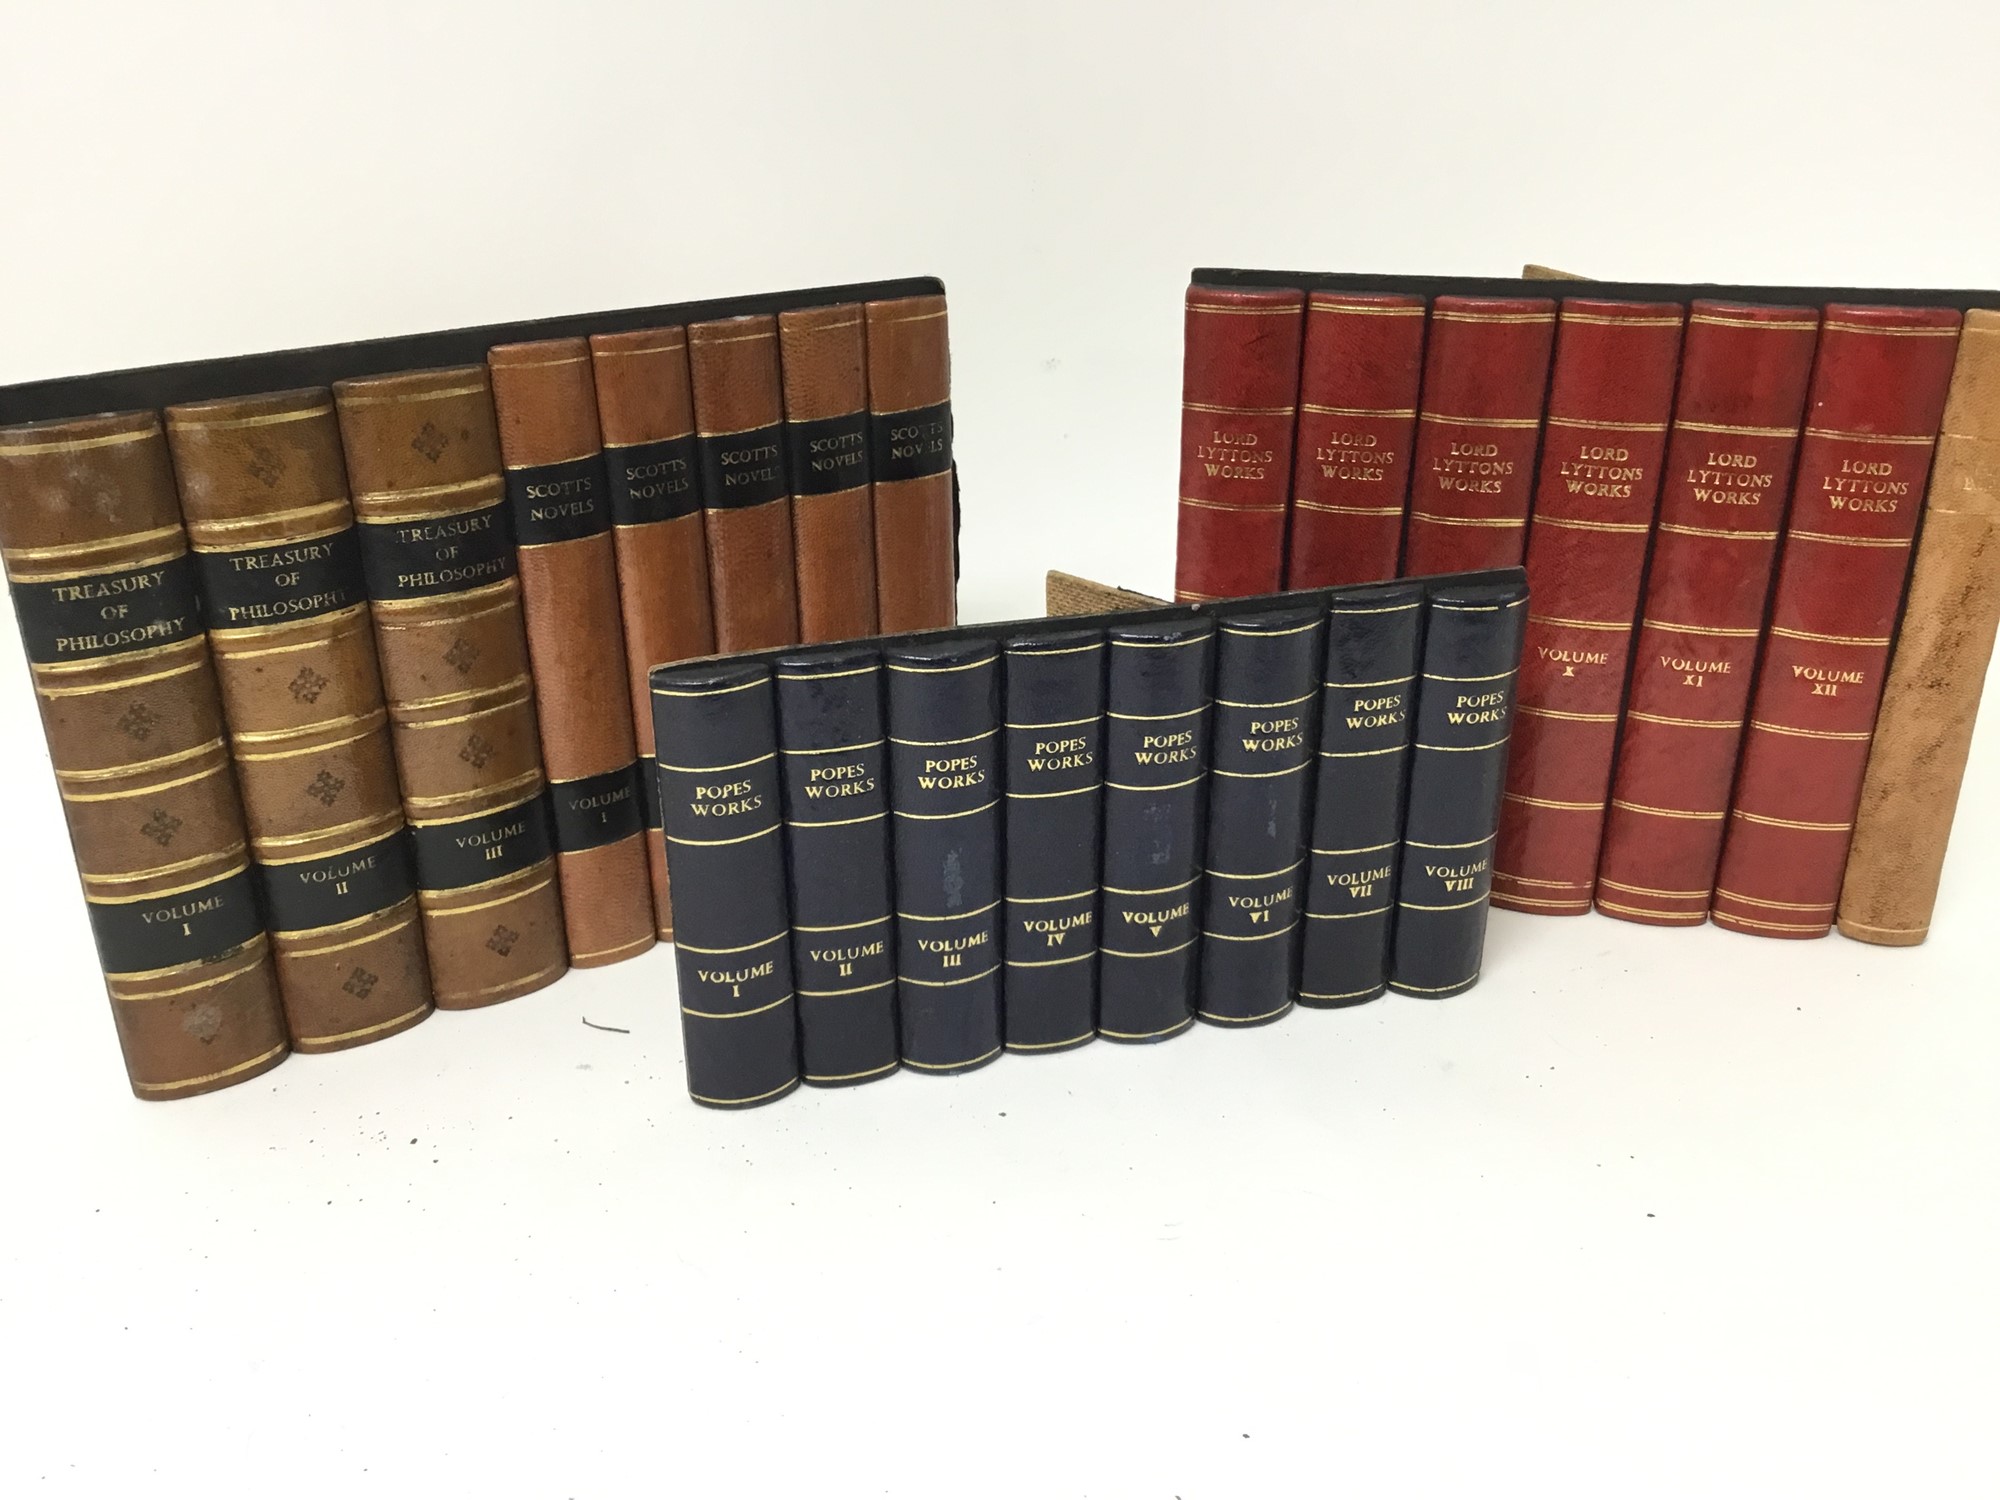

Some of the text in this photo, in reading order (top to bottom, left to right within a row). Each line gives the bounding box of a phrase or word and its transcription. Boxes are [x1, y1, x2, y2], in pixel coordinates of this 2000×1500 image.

[809, 431, 864, 453] SCOTTS
[1213, 431, 1258, 446] LORD
[1331, 431, 1377, 448] LORD
[721, 444, 779, 466] SCOTTS
[891, 438, 943, 460] NOVLS
[1197, 445, 1273, 463] LYTTONS
[1316, 447, 1395, 465] LYTTONS
[1450, 442, 1498, 457] LORD
[1579, 445, 1629, 462] LORD
[626, 457, 688, 481] SCOTTS
[811, 450, 864, 472] NOVELS
[1432, 457, 1514, 475] LYTTONS
[1707, 452, 1758, 469] LORD
[1841, 459, 1893, 476] LORD
[1204, 463, 1265, 480] WORKS
[1321, 464, 1384, 481] WORKS
[1560, 461, 1644, 481] LYTTONS
[1687, 469, 1773, 488] LYTTONS
[525, 476, 592, 499] SCOTTS
[629, 477, 689, 500] NOVELS
[1438, 475, 1502, 494] WORKS
[1565, 479, 1632, 498] WORKS
[1822, 476, 1910, 496] LYTTONS
[1693, 487, 1762, 506] WORKS
[1829, 495, 1898, 513] WORKS
[529, 499, 595, 522] NOVELS
[395, 514, 493, 544] TREASURY
[229, 543, 334, 572] TREASURY
[435, 545, 459, 561] OF
[275, 571, 300, 587] OF
[398, 556, 508, 588] PHILOSOPHY
[52, 570, 165, 602] TREASURY
[100, 604, 129, 620] OF
[55, 617, 187, 653] PHILOSOPHY
[1538, 646, 1609, 666] VOLUME
[1660, 656, 1732, 675] VOLUME
[1562, 666, 1575, 678] X
[1682, 674, 1704, 688] XI
[1791, 665, 1865, 685] VOLUME
[1456, 690, 1504, 709] POPES
[1810, 683, 1838, 698] XII
[1354, 694, 1401, 712] POPES
[1345, 709, 1406, 730] WORKS
[1447, 705, 1508, 726] WORKS
[1249, 717, 1300, 735] POPES
[1035, 736, 1087, 755] POPES
[1143, 730, 1192, 749] POPES
[1242, 731, 1304, 753] WORKS
[925, 755, 978, 773] POPES
[1027, 751, 1094, 772] WORKS
[1134, 745, 1197, 766] WORKS
[810, 763, 865, 783] POPES
[917, 769, 985, 790] WORKS
[695, 779, 751, 800] POPES
[804, 777, 875, 799] WORKS
[568, 785, 632, 811] VOLUME
[690, 794, 762, 818] WORKS
[601, 811, 607, 823] I
[455, 821, 527, 849] VOLUME
[485, 845, 503, 861] III
[299, 855, 379, 884] VOLUME
[1327, 865, 1392, 886] VOLUME
[1425, 857, 1488, 878] VOLUME
[335, 881, 349, 895] II
[1349, 884, 1373, 898] VII
[1444, 877, 1475, 893] VIII
[1228, 885, 1294, 909] VOLUME
[141, 895, 224, 924] VOLUME
[1122, 902, 1190, 924] VOLUME
[1249, 911, 1270, 924] VI
[183, 923, 192, 936] I
[1023, 911, 1093, 933] VOLUME
[1149, 925, 1162, 938] V
[917, 930, 989, 953] VOLUME
[1047, 932, 1066, 947] IV
[810, 940, 885, 963] VOLUME
[942, 953, 962, 968] III
[697, 960, 774, 983] VOLUME
[839, 963, 853, 977] II
[732, 984, 740, 998] I
